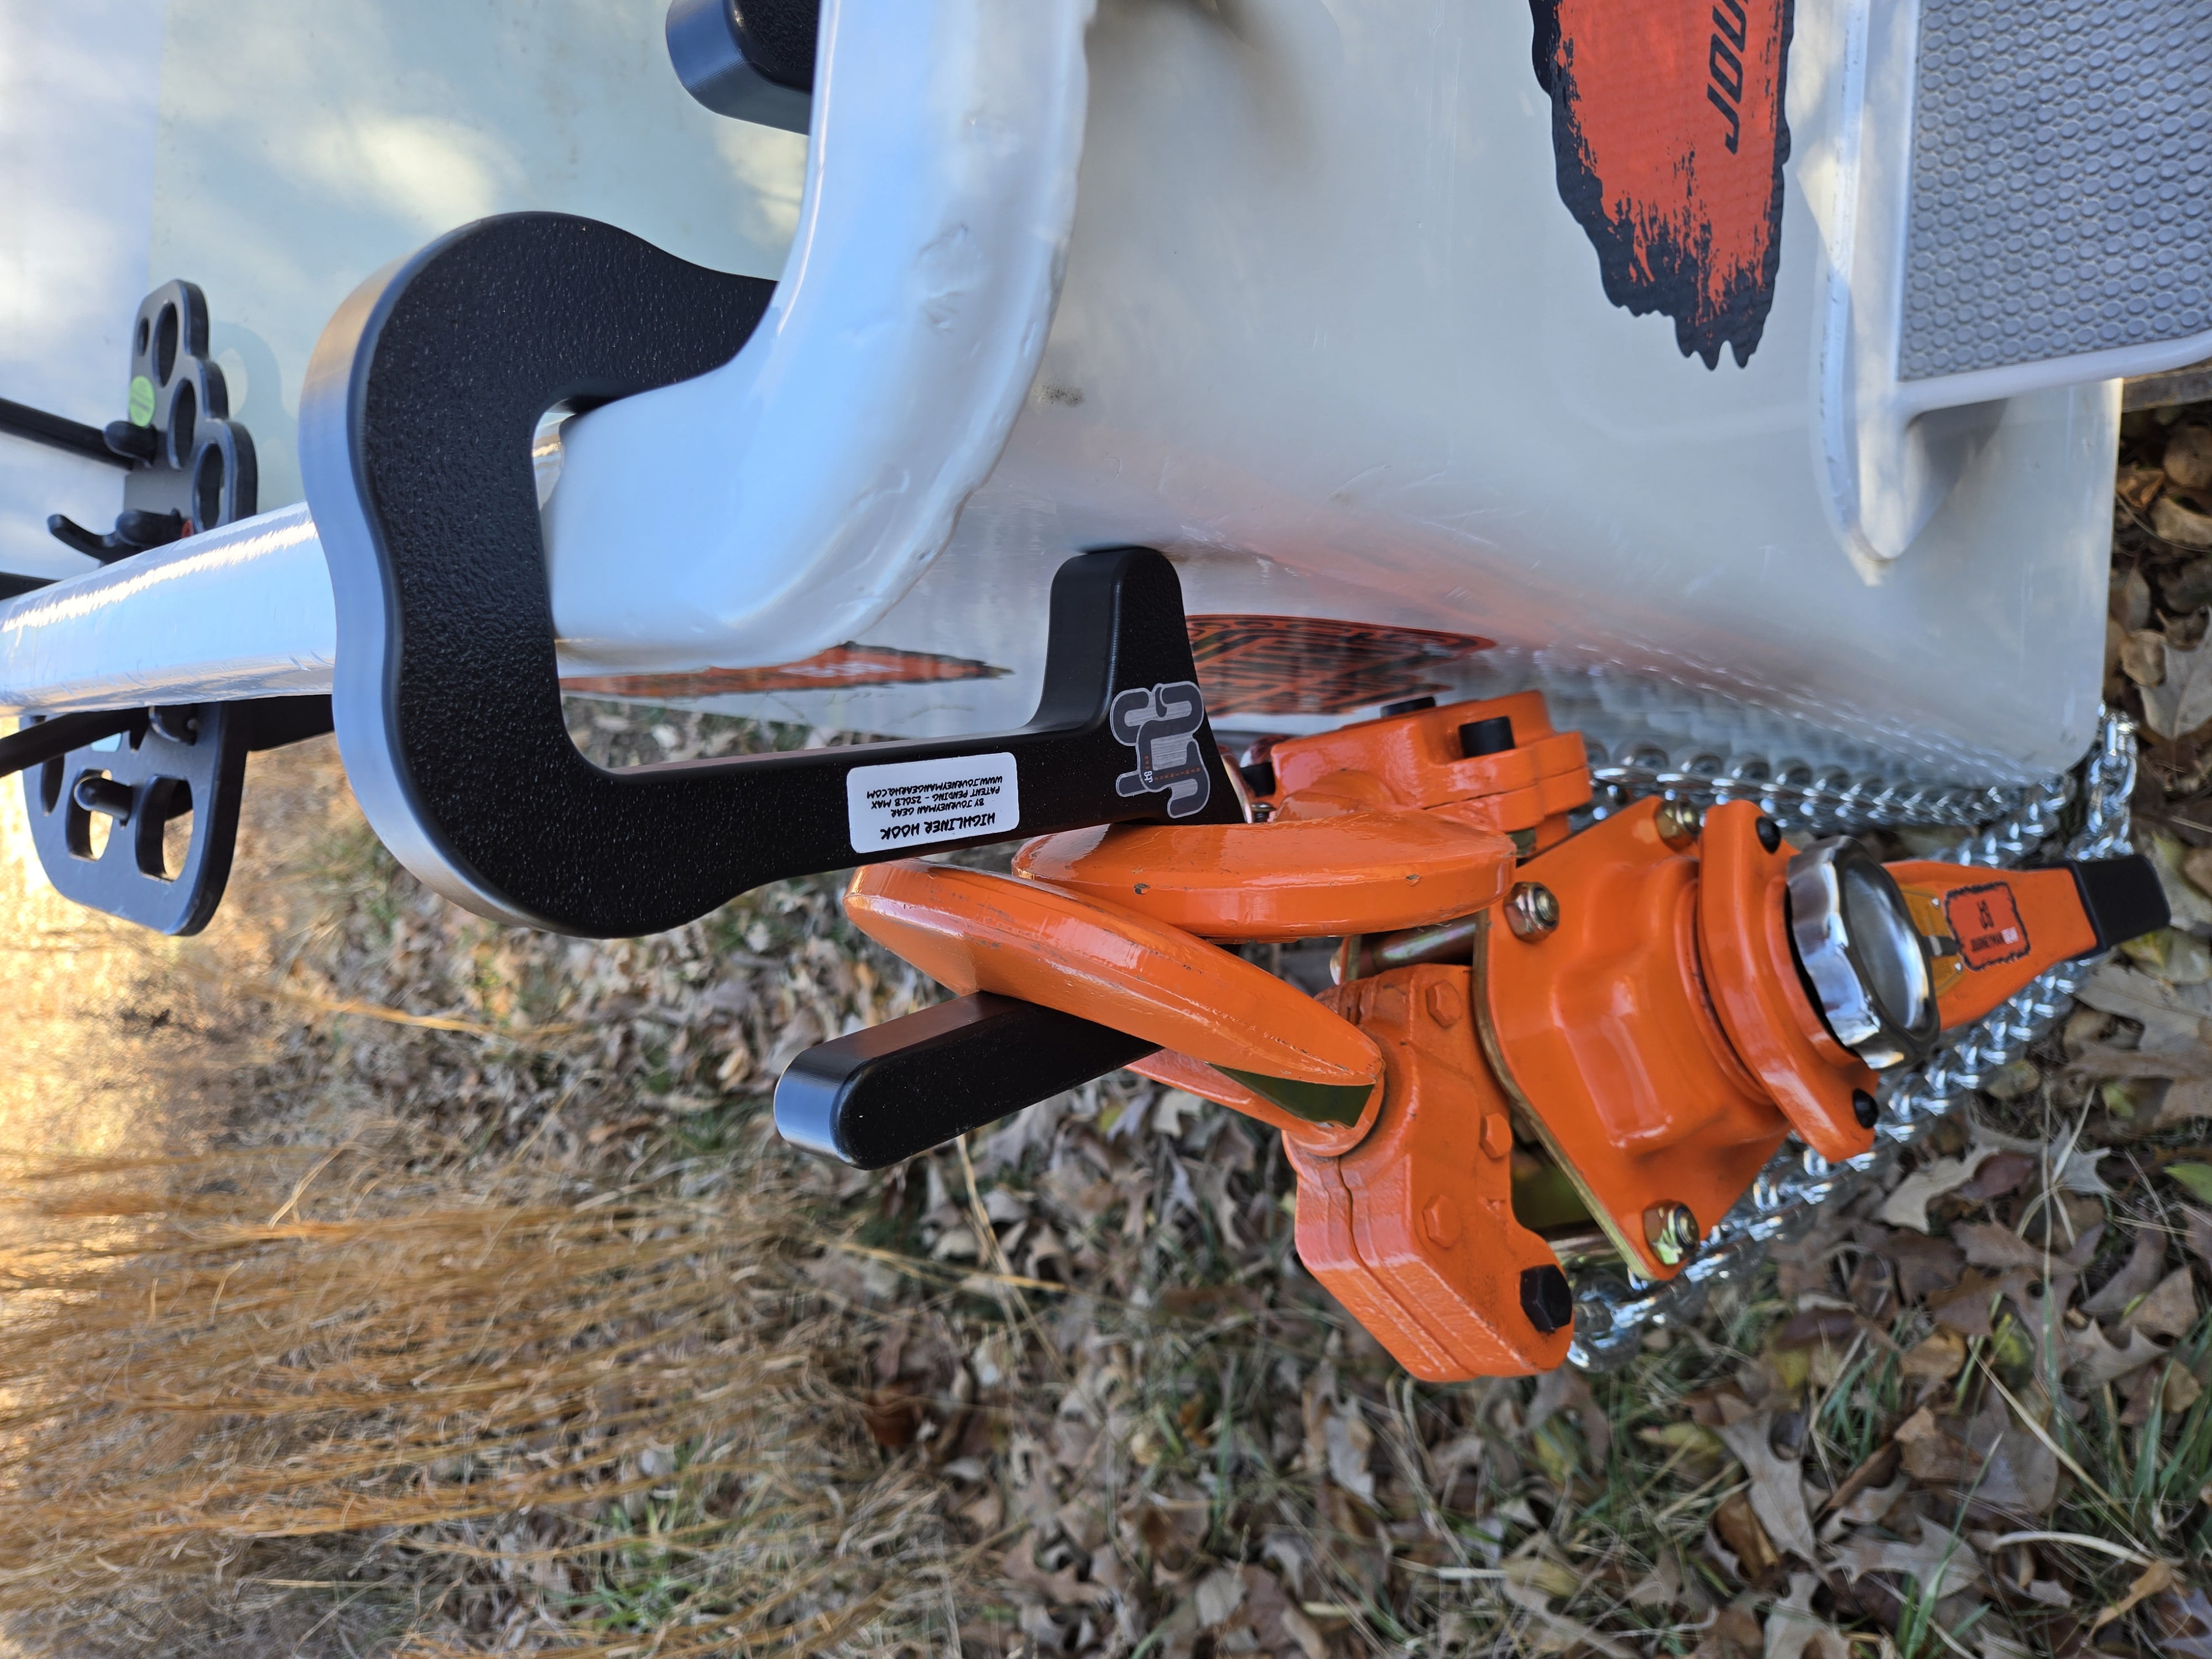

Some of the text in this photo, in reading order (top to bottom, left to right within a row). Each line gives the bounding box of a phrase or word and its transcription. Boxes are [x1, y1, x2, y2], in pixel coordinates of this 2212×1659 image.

[1707, 0, 1749, 155] JOU
[867, 776, 1003, 799] WWW.JOURNEYMANGEARHQ.COM
[970, 786, 1000, 797] PATENT
[895, 796, 921, 805] 250LB
[932, 790, 968, 802] PENDING
[871, 799, 892, 809] MAX
[891, 798, 984, 817] BY JOURNEYMAN GEAR
[880, 812, 995, 839] HIGHLINER HOOK
